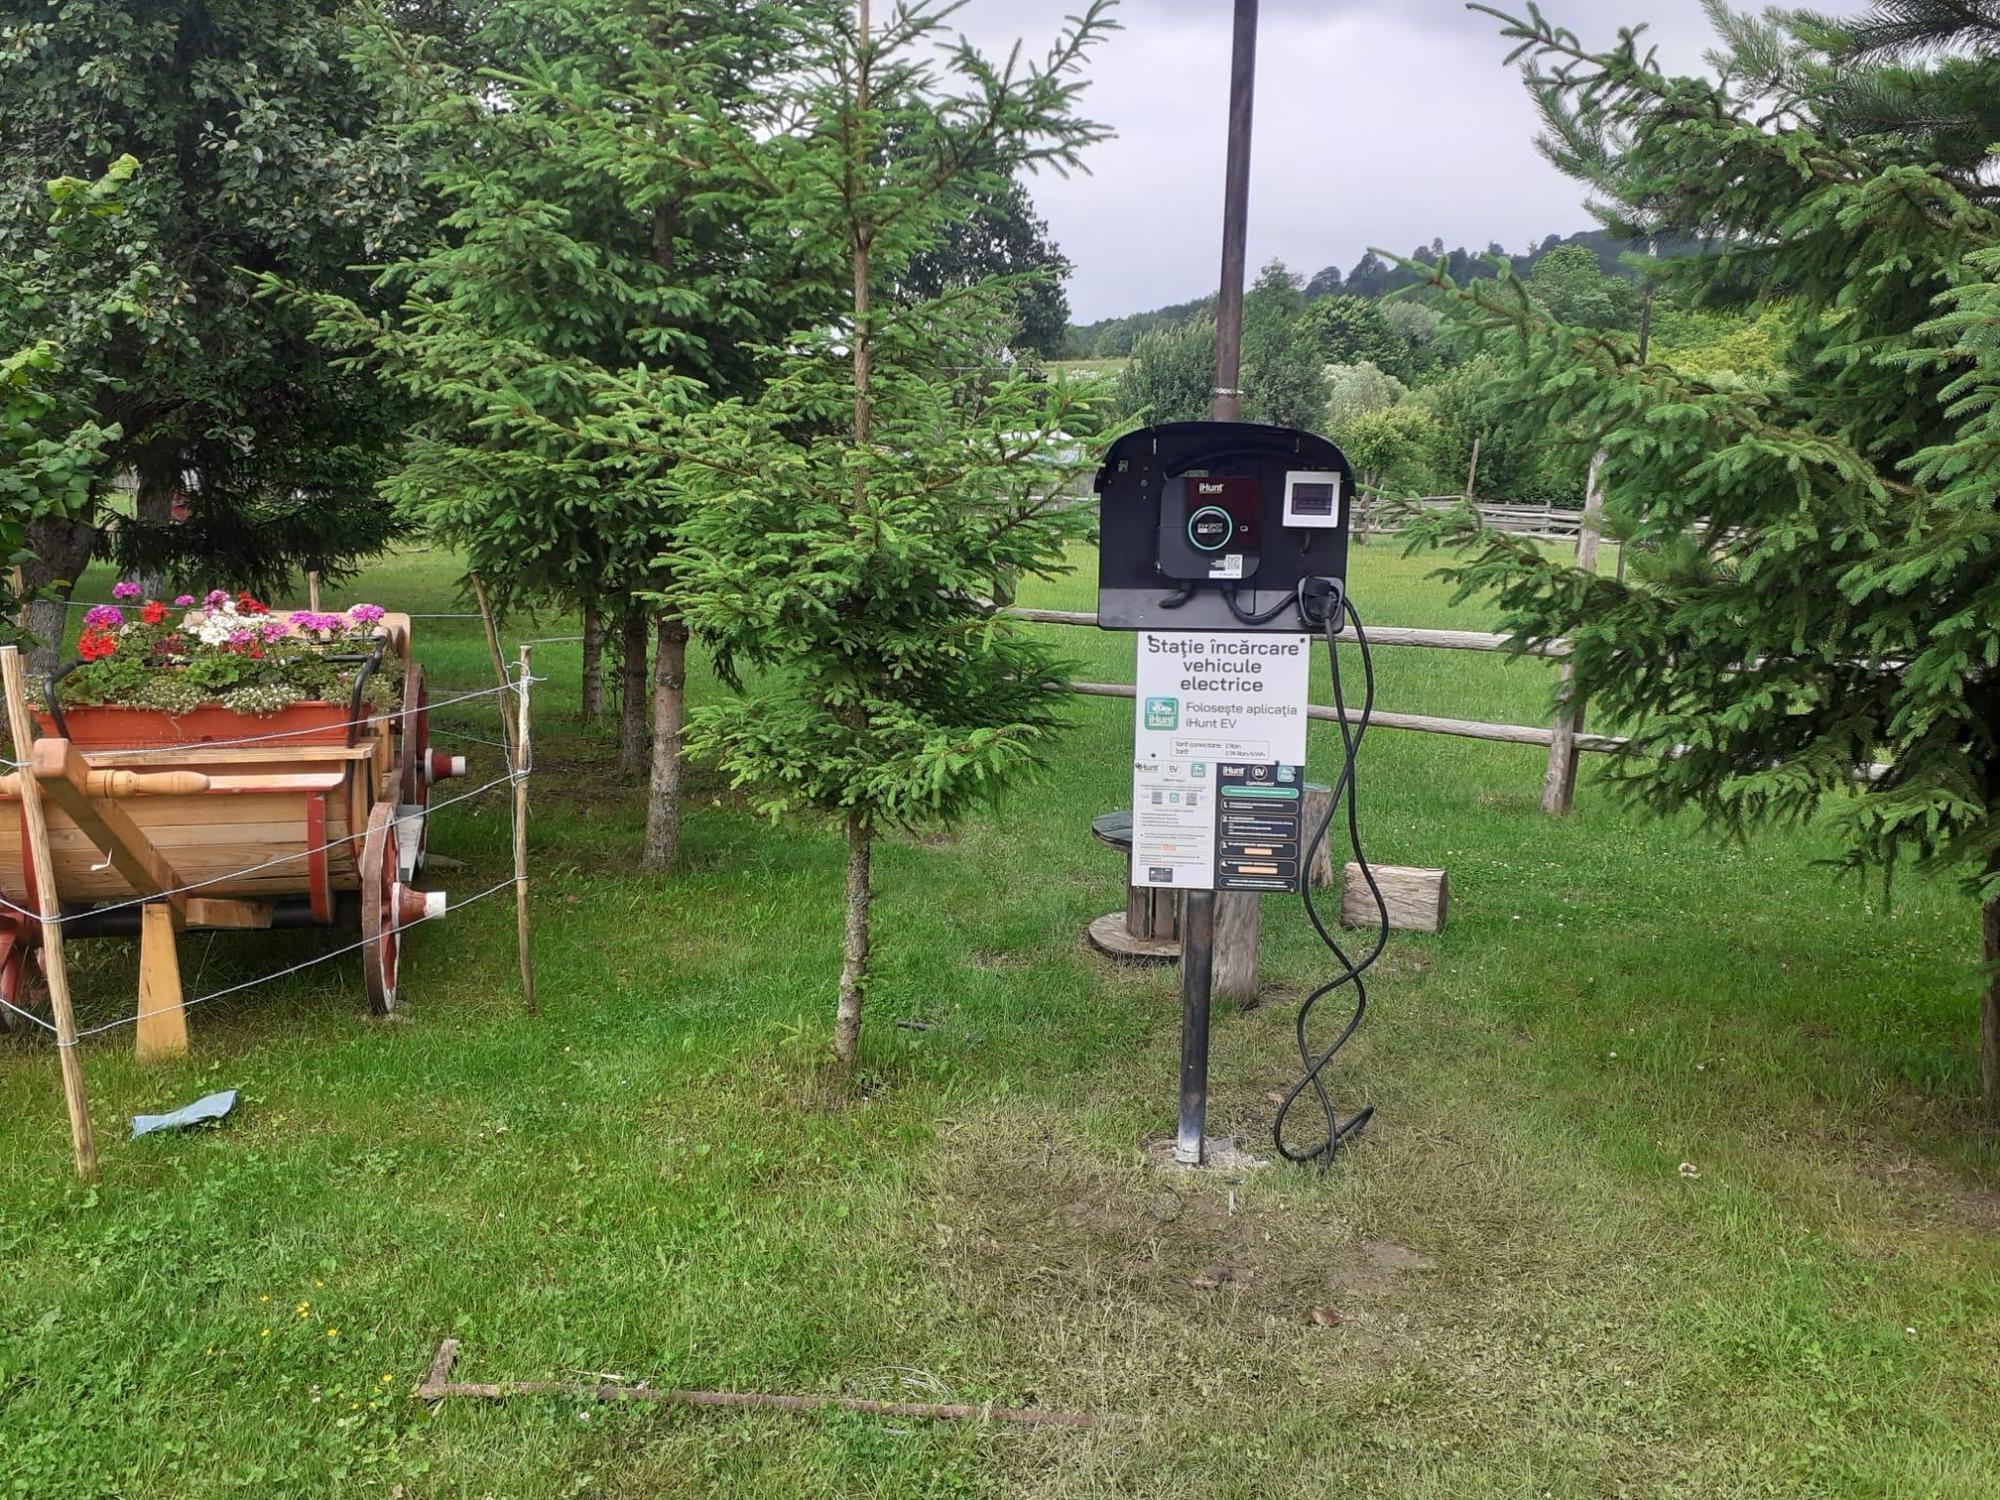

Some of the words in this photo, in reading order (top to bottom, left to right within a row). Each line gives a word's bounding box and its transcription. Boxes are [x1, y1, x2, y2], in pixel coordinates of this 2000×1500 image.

[1199, 483, 1224, 492] iHunt
[1210, 640, 1299, 656] încărcare
[1183, 658, 1262, 674] vehicule
[1180, 676, 1264, 692] electrice
[1148, 715, 1175, 725] iHunt
[1186, 718, 1217, 729] iHunt
[1220, 719, 1237, 729] EV
[1223, 766, 1245, 774] iHunt
[1254, 768, 1265, 776] EV
